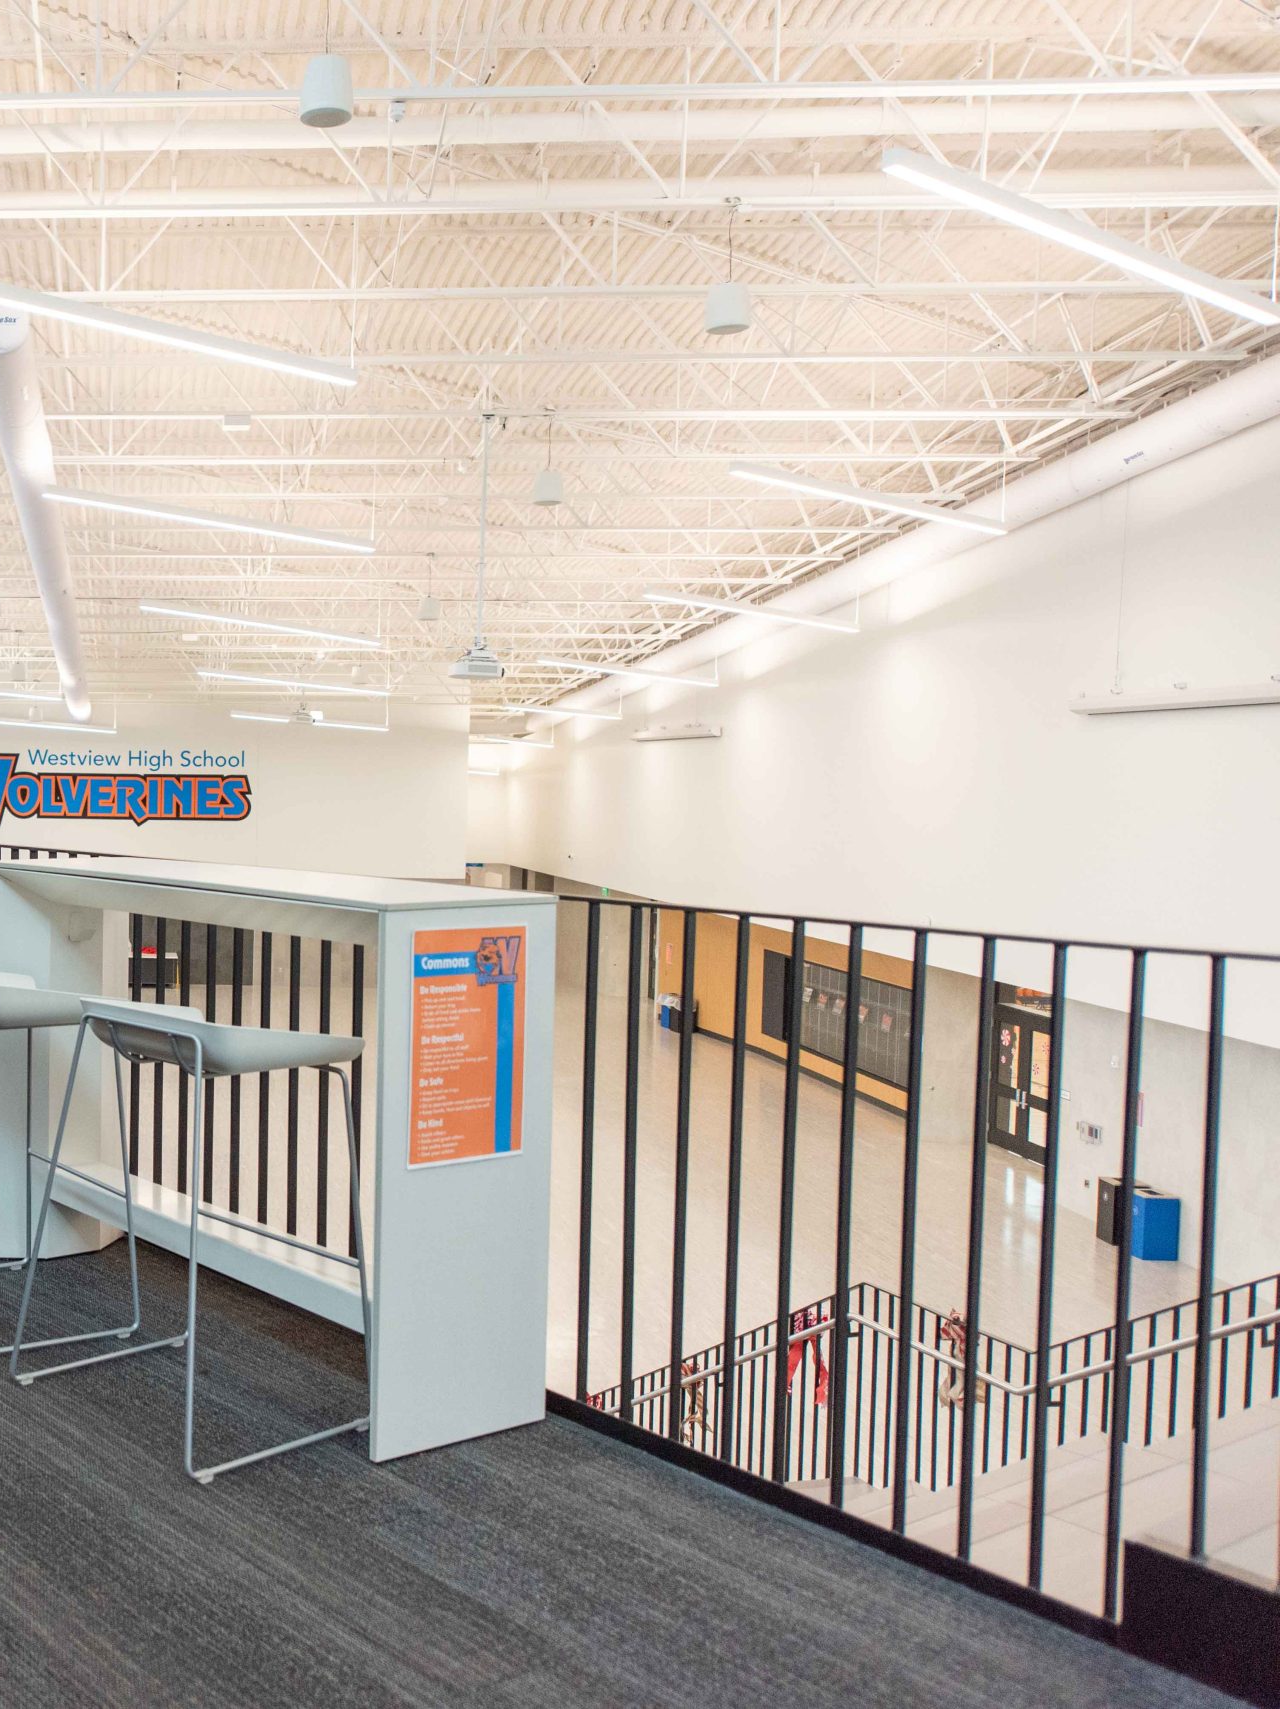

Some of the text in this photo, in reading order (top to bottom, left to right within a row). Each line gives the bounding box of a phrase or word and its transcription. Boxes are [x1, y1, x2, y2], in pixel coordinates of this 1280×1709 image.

[28, 749, 245, 772] Westview High School
[421, 956, 470, 970] Commons
[429, 1076, 444, 1087] Safe
